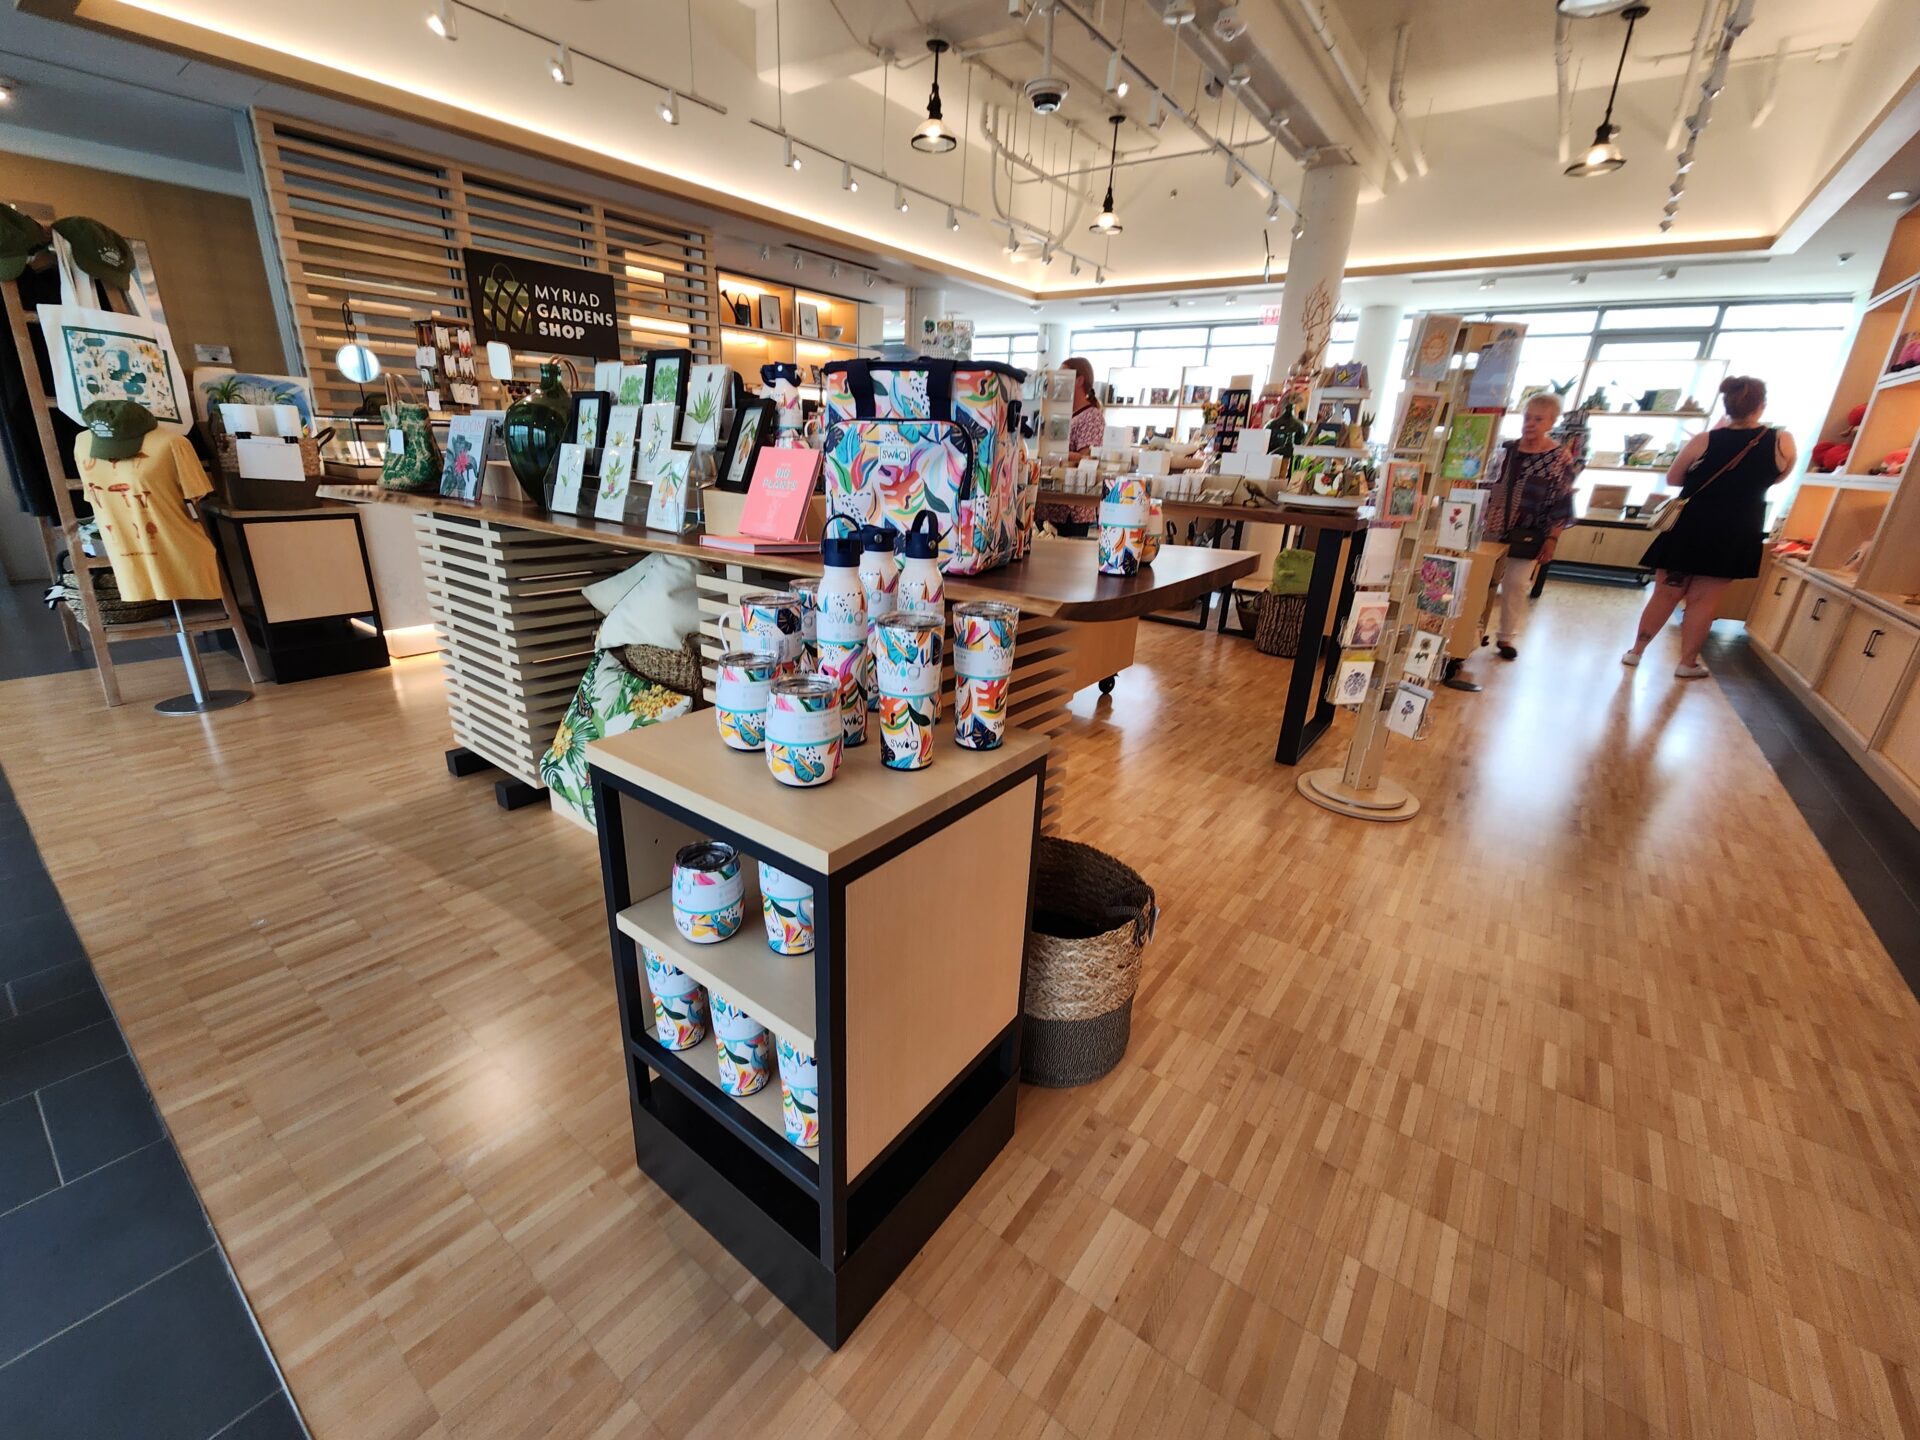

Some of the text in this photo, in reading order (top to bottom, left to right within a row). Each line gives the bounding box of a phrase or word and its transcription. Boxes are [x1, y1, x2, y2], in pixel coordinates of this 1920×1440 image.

[534, 284, 600, 307] MYRIAD
[536, 303, 614, 327] GARDENS
[538, 321, 585, 340] SHOP
[890, 738, 918, 750] swig
